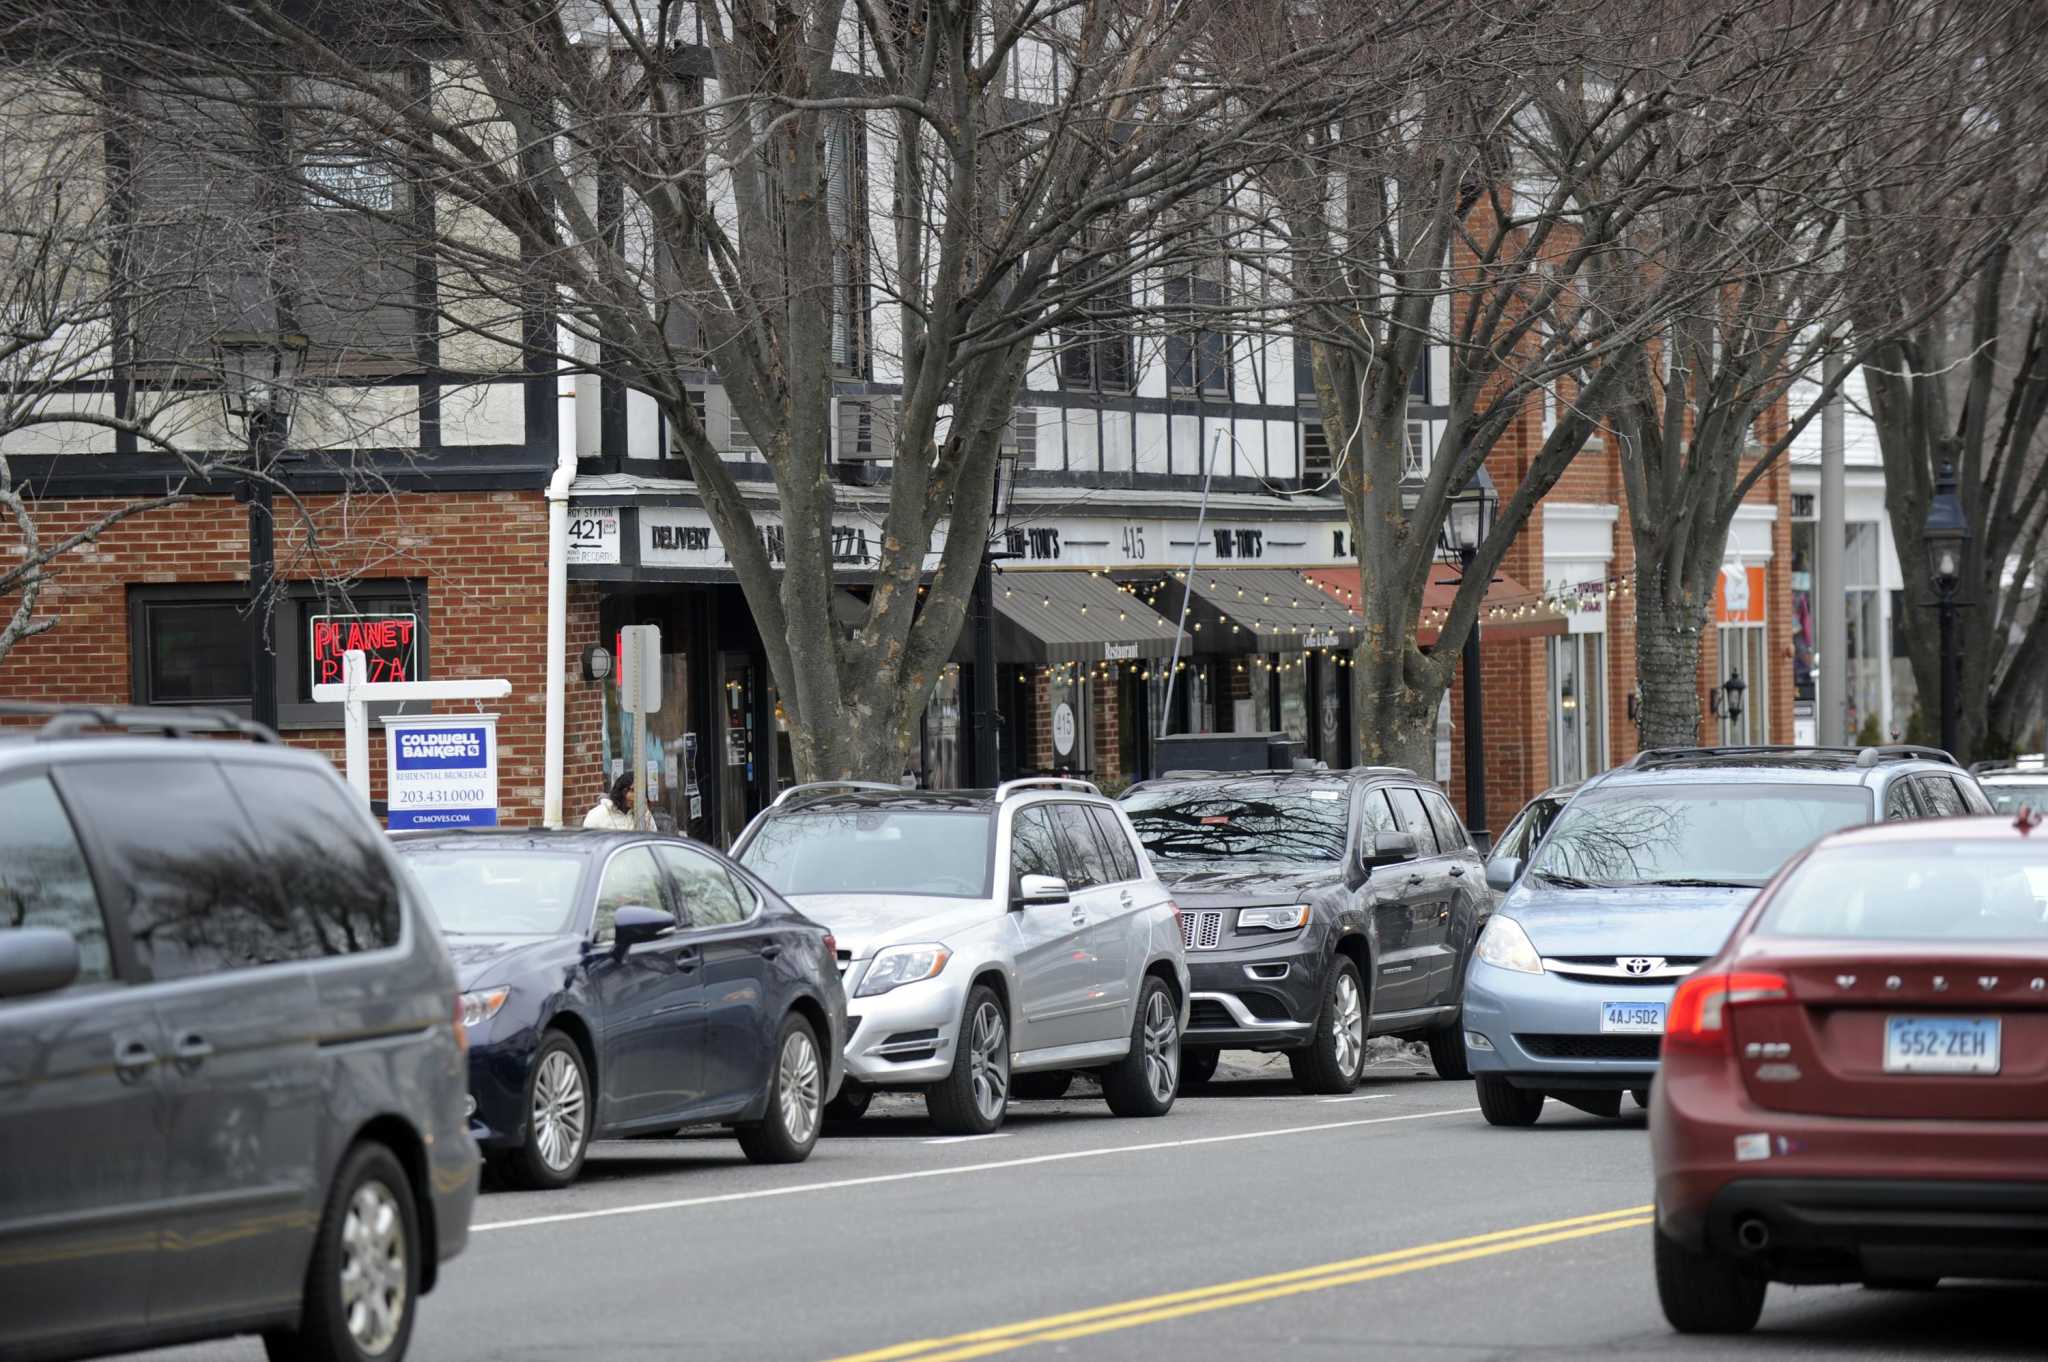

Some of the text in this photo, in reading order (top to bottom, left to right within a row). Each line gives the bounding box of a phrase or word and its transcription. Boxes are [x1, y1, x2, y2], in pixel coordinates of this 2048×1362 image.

[568, 519, 602, 539] 421
[652, 526, 711, 550] DELIVERY
[1122, 526, 1145, 559] 415
[315, 620, 413, 660] PLANET
[1104, 641, 1138, 660] Restaurant
[322, 657, 406, 684] PZA
[1056, 711, 1072, 735] 415
[396, 770, 488, 780] RESIDENTIAL BROKERAGE
[400, 788, 485, 802] 203.431.0000
[412, 814, 471, 823] CBMOVES.COM
